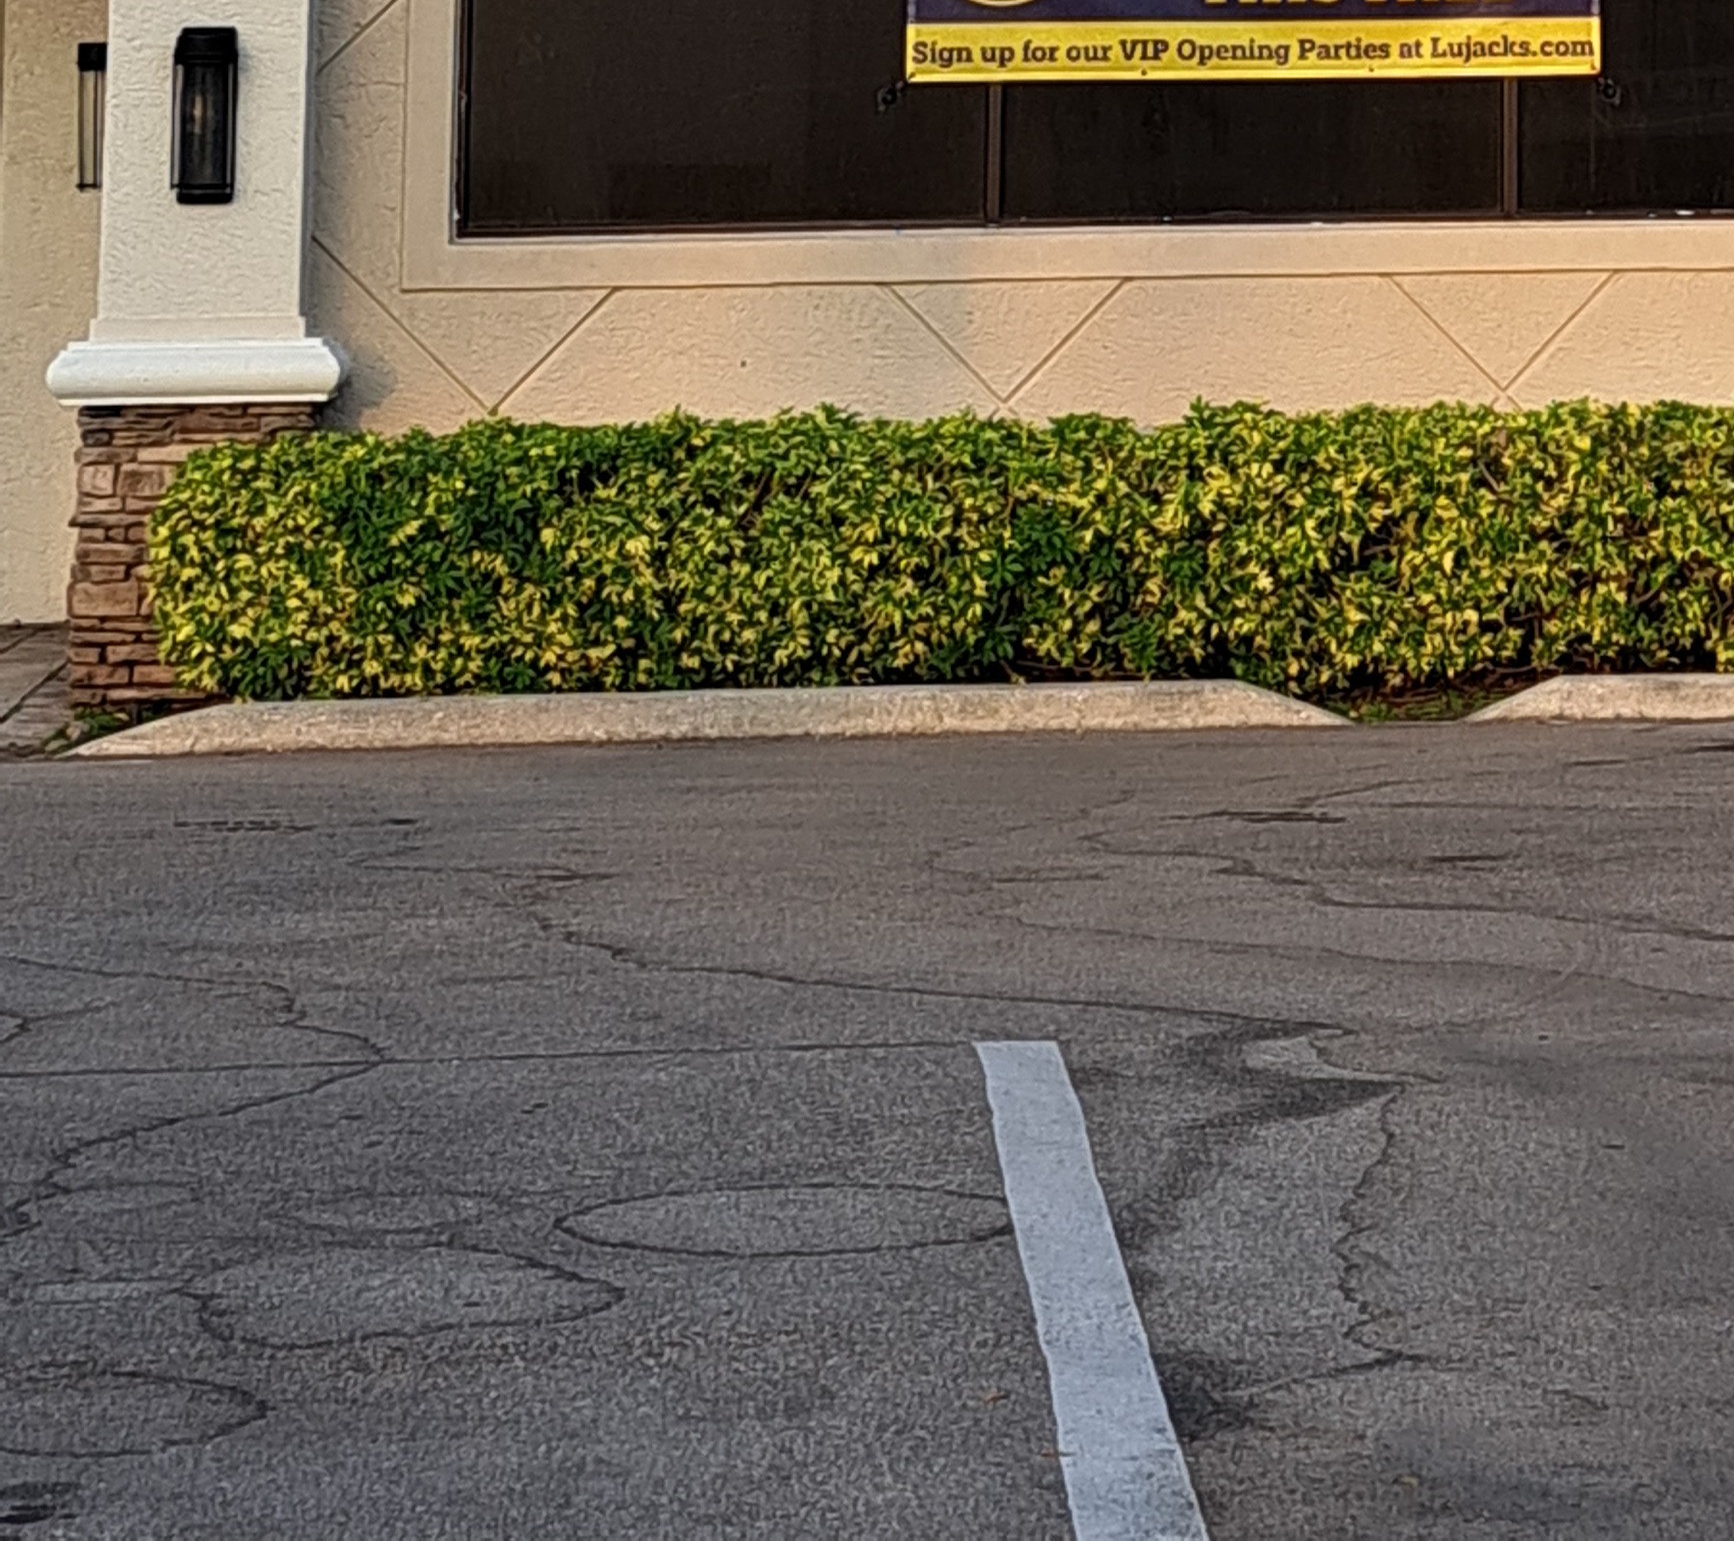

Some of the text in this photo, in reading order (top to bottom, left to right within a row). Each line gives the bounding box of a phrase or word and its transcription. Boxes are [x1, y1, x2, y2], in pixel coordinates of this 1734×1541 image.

[912, 35, 1594, 67] Sign up for our VIP Opening Parties at Lujacks.com
